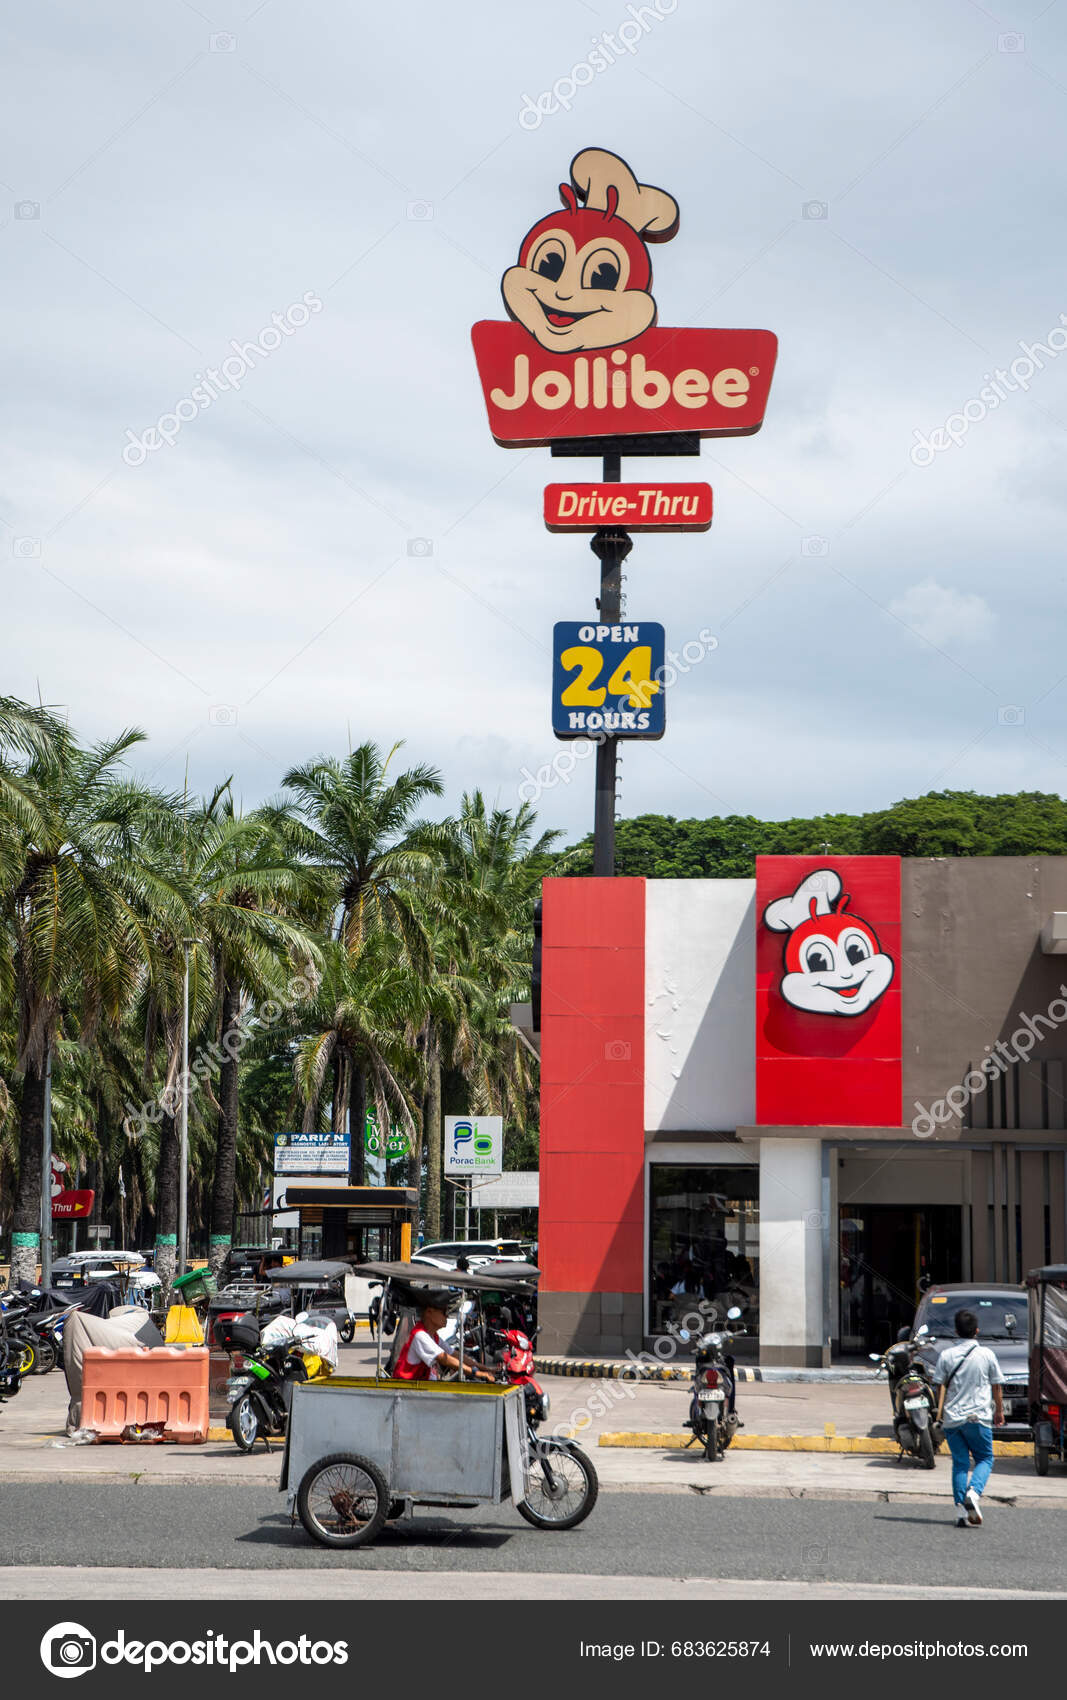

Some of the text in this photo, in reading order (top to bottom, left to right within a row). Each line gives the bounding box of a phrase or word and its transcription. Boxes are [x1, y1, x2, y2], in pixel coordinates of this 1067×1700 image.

[557, 490, 700, 517] Drive-Thru
[578, 625, 640, 643] OPEN
[560, 646, 660, 708] 24
[568, 712, 650, 730] HOURS
[368, 1137, 406, 1150] Oer
